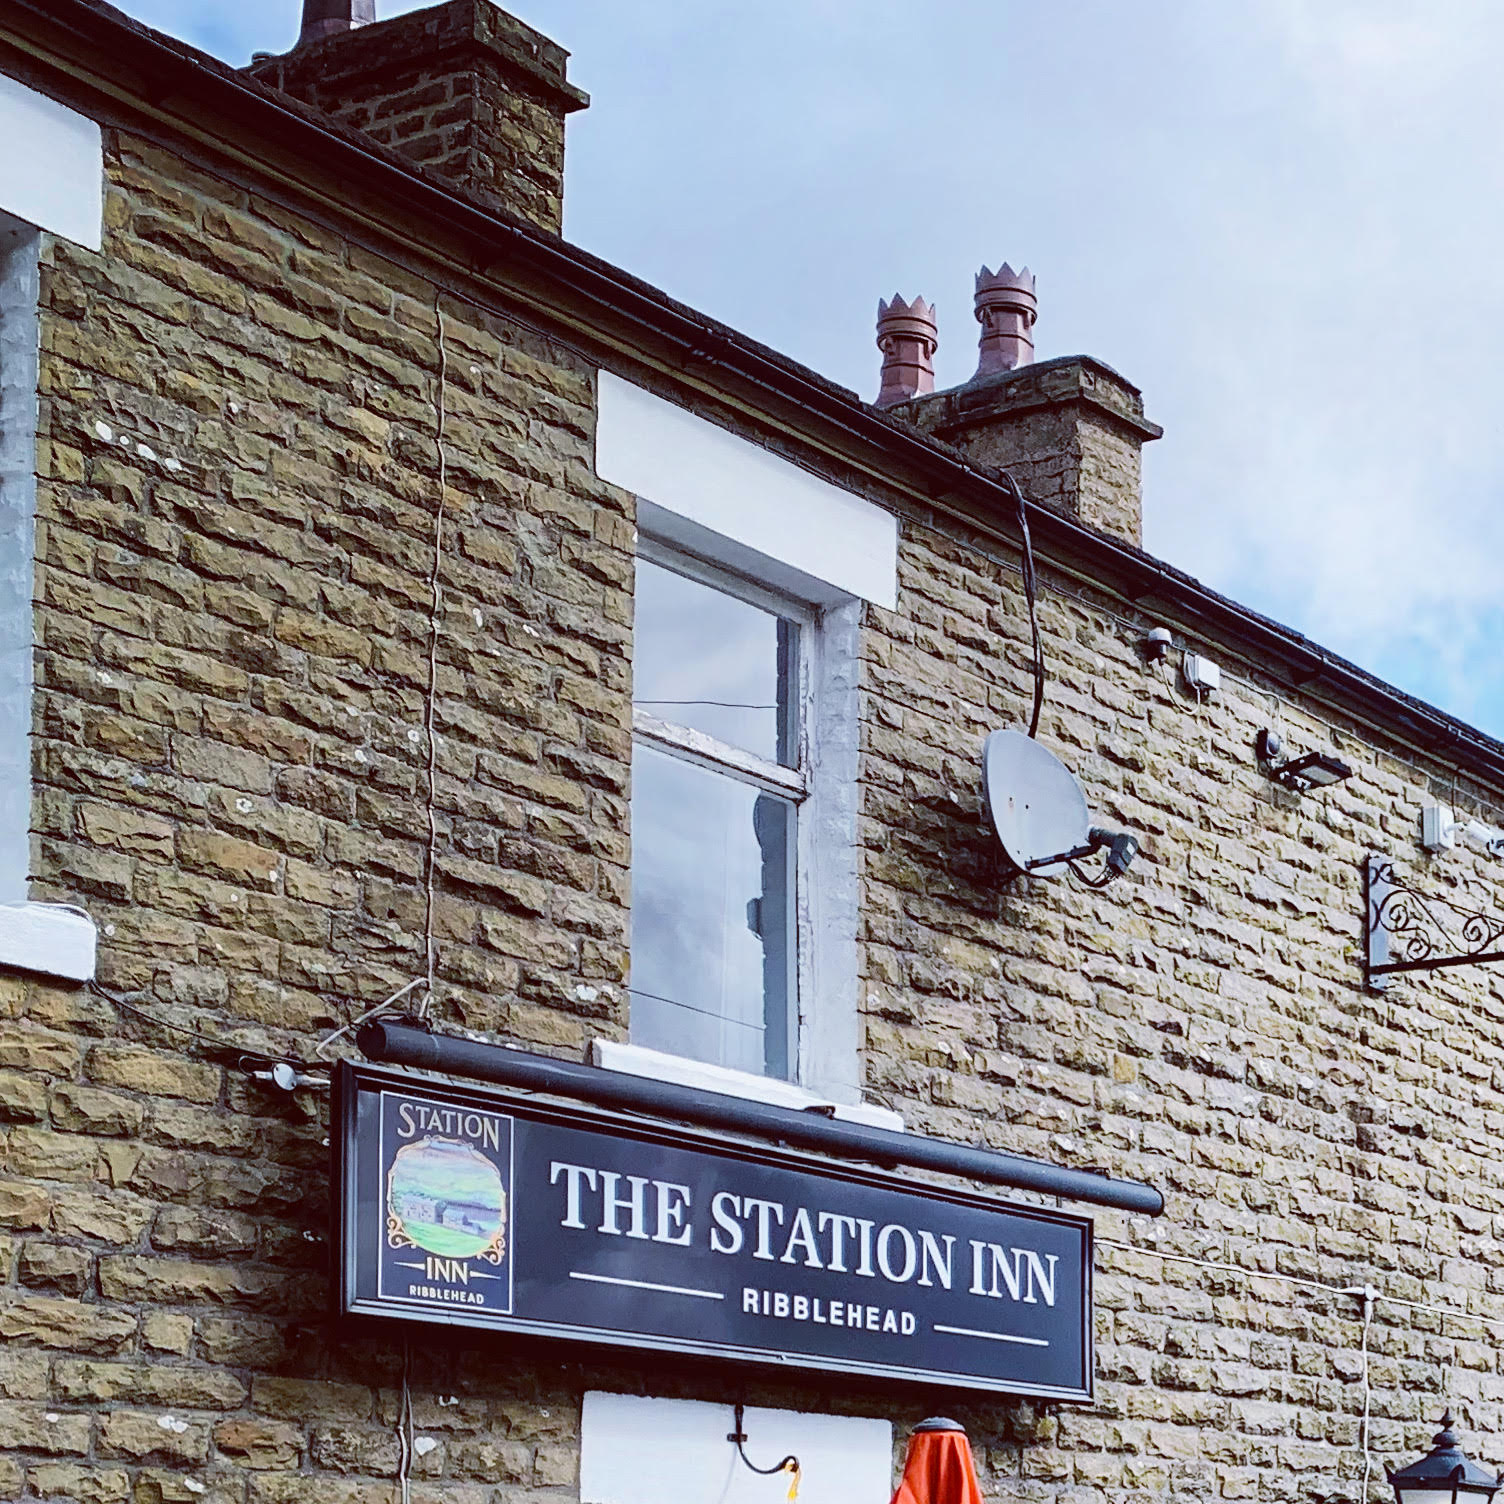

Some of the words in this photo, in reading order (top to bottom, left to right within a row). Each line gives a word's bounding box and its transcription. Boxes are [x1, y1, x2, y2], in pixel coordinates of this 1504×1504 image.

[397, 1102, 500, 1152] STATION
[549, 1160, 693, 1247] THE
[710, 1190, 957, 1291] STATION
[968, 1239, 1061, 1308] INN
[409, 1284, 485, 1305] RIBBLEHEAD
[425, 1256, 468, 1286] INN
[742, 1286, 918, 1337] RIBBLEHEAD
